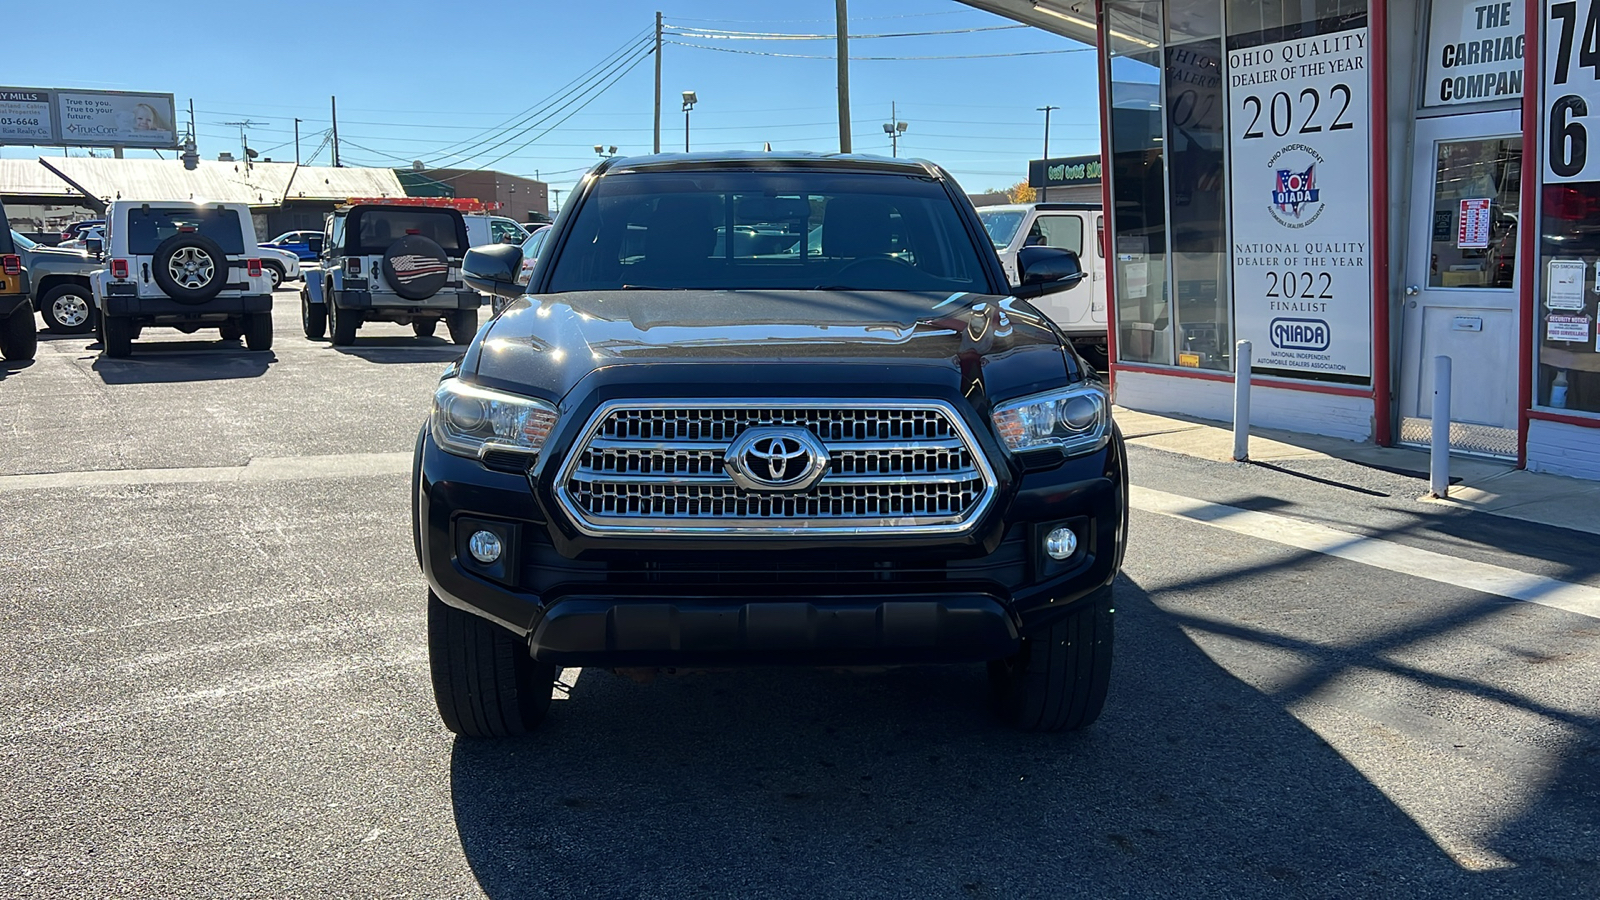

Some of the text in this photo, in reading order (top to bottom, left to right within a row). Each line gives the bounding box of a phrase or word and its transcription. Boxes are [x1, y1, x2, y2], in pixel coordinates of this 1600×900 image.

[1475, 2, 1511, 29] THE
[1230, 48, 1274, 69] OHIO
[1282, 32, 1366, 63] QUALITY
[1168, 46, 1211, 69] HIO
[1232, 56, 1364, 88] DEALER OF THE YEAR
[10, 93, 38, 101] MILLS
[66, 105, 84, 113] True
[1242, 83, 1353, 140] 2022
[1, 117, 39, 126] 03-6648
[17, 127, 36, 136] Realty
[75, 124, 118, 134] TrueCore
[1550, 94, 1588, 177] 6
[1267, 143, 1325, 168] OHIO INDEPENDENT
[1277, 191, 1312, 203] OIADA
[1267, 205, 1287, 227] AUTOMOBILE
[1304, 202, 1326, 227] ASSOCIATION
[1236, 242, 1365, 254] NATIONAL QUALITY
[1237, 257, 1364, 267] DEALER OF THE YEAR
[1265, 271, 1333, 299] 2022
[1270, 301, 1327, 312] FINALIST
[1275, 324, 1324, 344] NIADA
[1271, 351, 1331, 361] NATIONAL INDEPENDENT
[1257, 358, 1346, 371] AUTOMOBILE DEALERS ASSOCIATION
